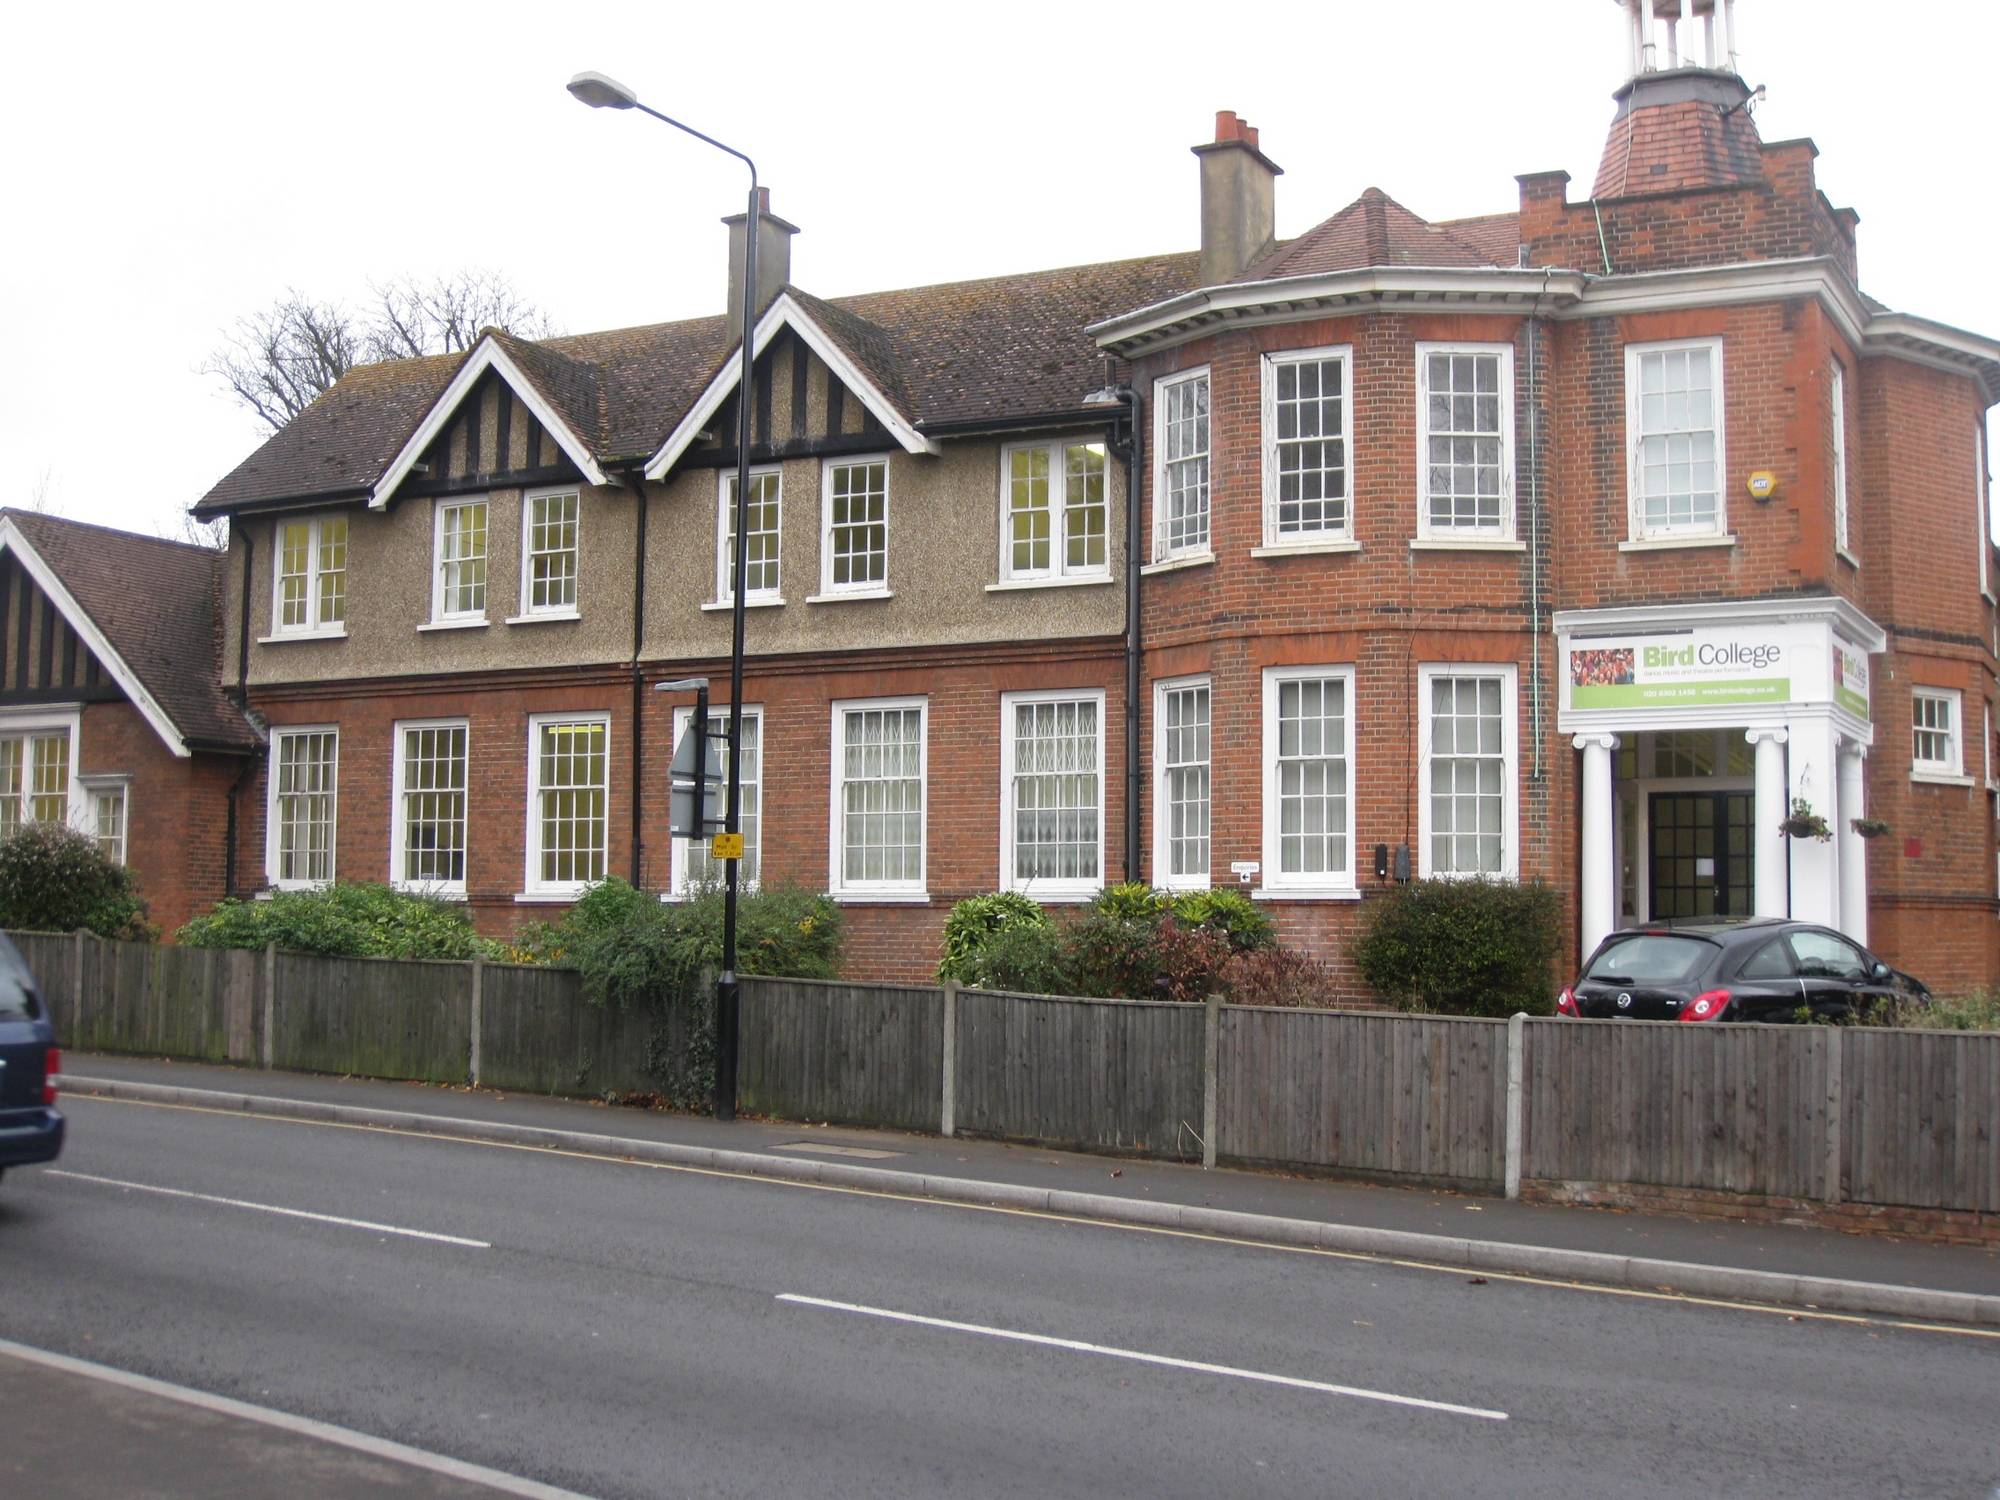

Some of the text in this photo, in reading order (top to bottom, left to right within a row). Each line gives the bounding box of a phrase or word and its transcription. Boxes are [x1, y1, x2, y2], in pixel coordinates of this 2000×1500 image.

[1753, 479, 1767, 489] ADT
[1643, 642, 1781, 669] Bird College
[1663, 668, 1680, 676] music
[1681, 667, 1692, 675] and
[1693, 665, 1713, 674] theatre
[1714, 666, 1751, 674] performance
[1643, 690, 1657, 698] 020
[1701, 686, 1776, 695] www.birdcollege.co.uk
[1233, 863, 1258, 871] Enquiries
